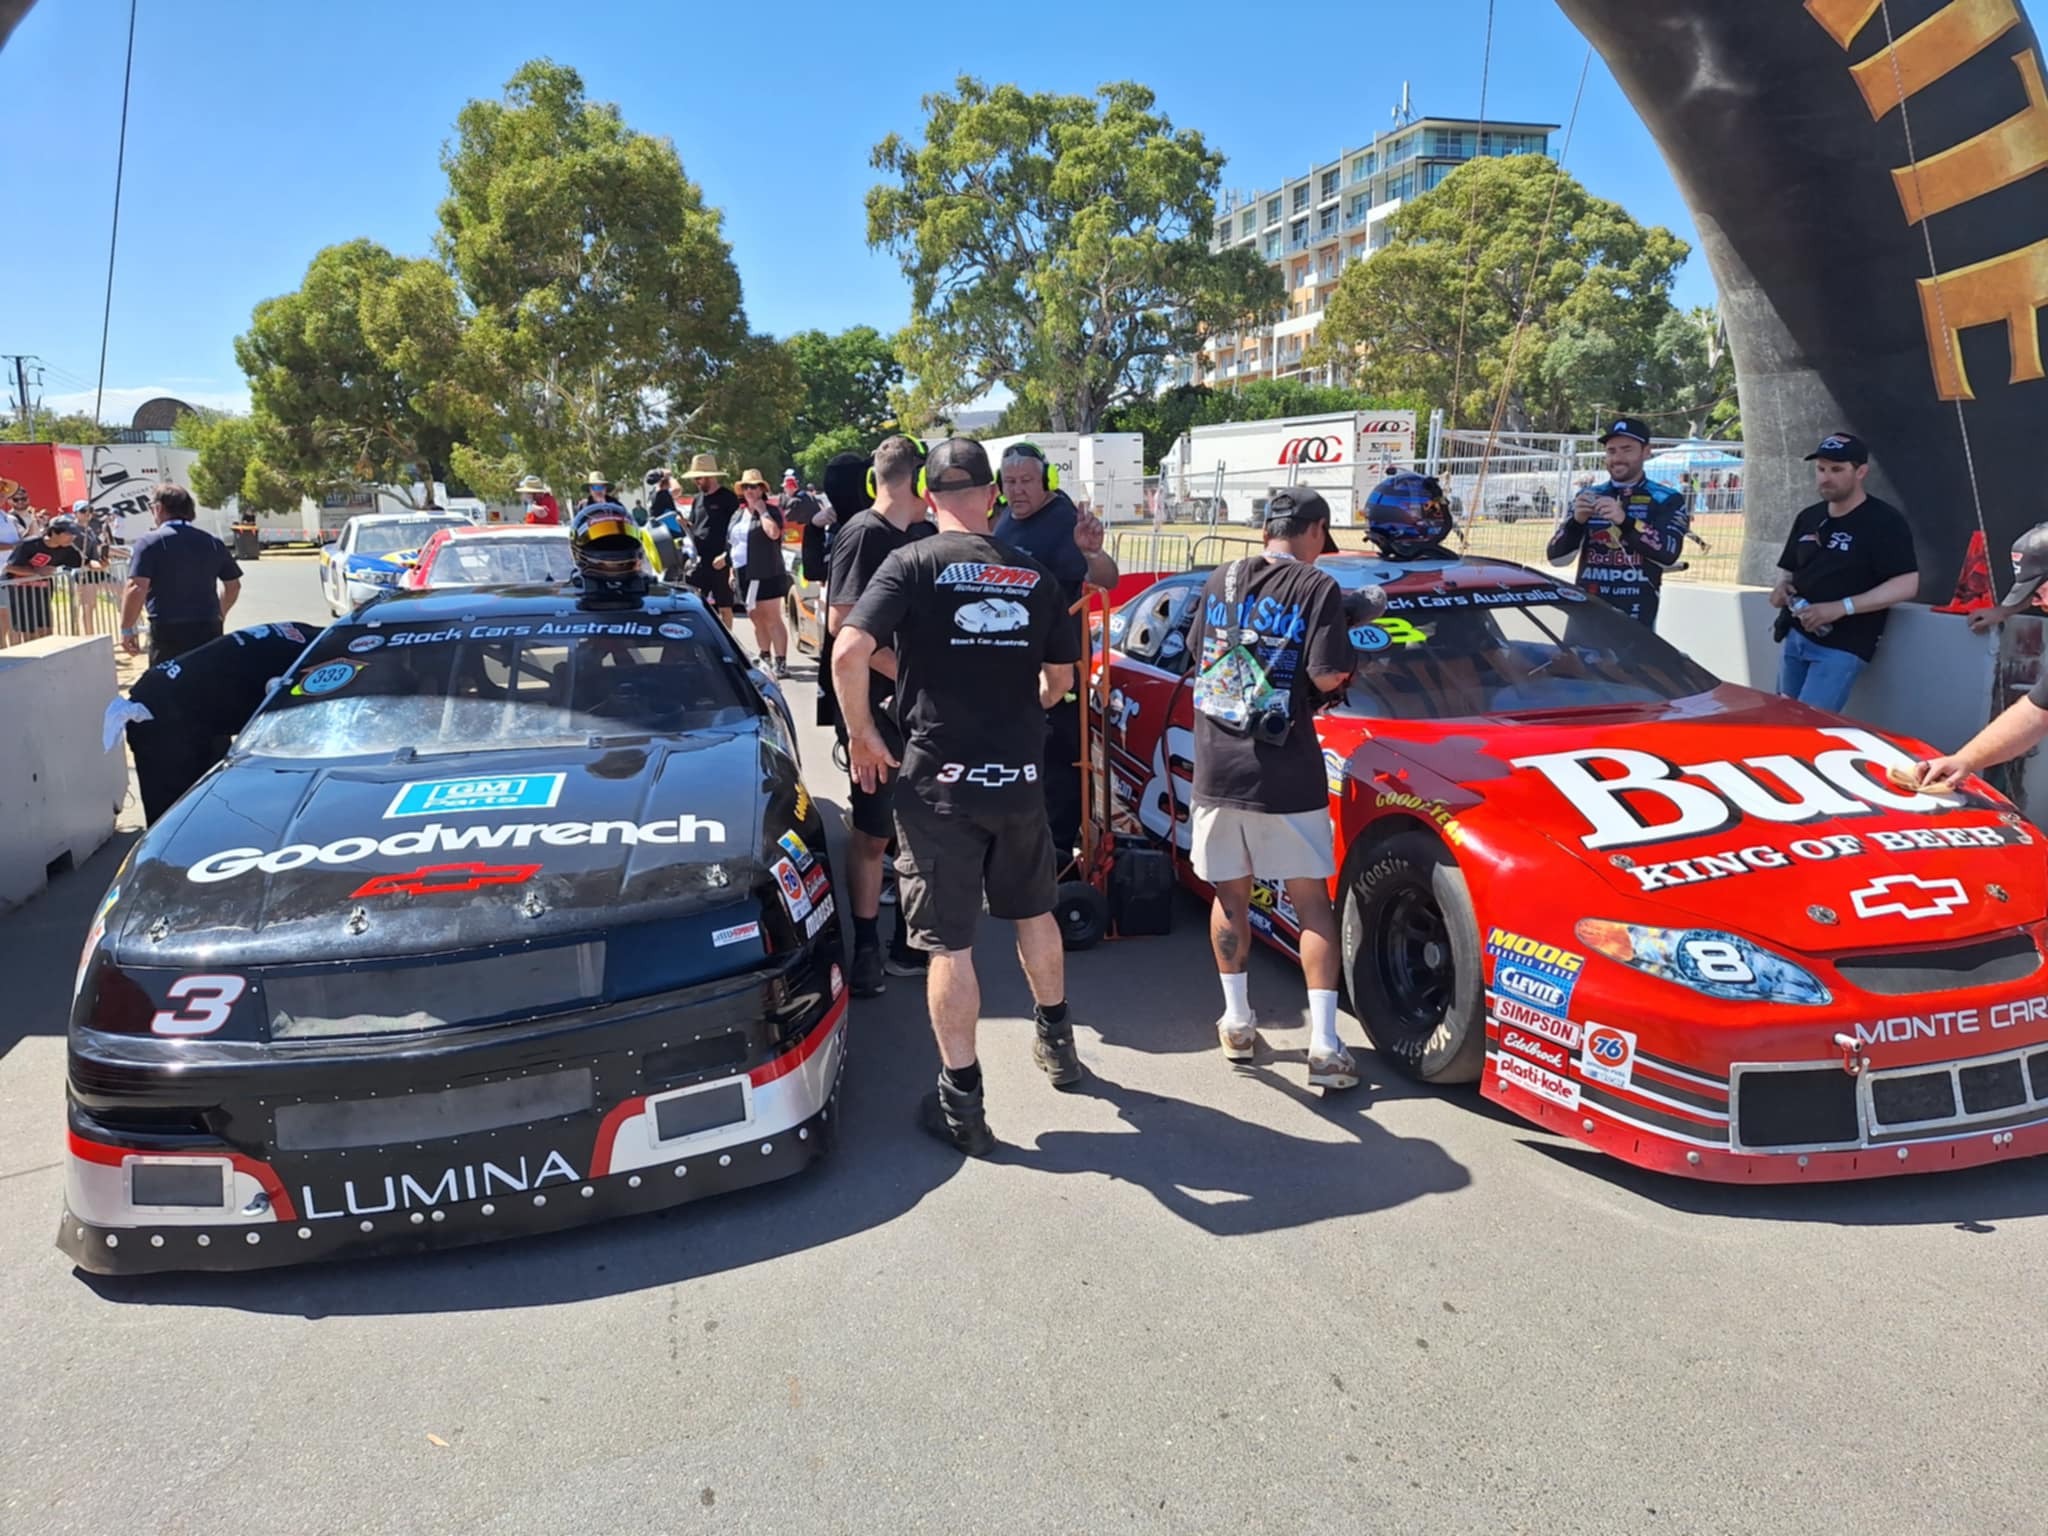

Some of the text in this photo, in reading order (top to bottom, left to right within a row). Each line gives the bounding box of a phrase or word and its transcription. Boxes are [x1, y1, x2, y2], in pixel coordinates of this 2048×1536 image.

[1581, 567, 1649, 582] AMPOL
[1418, 594, 1469, 608] Cars
[1472, 585, 1559, 604] Australia
[387, 627, 464, 646] Stock
[470, 624, 532, 638] Cars
[537, 622, 653, 636] Australia
[1352, 628, 1380, 646] 28
[312, 667, 348, 684] 333
[447, 779, 513, 796] GM
[936, 762, 1038, 783] 3 8
[1513, 727, 1968, 850] Bud
[422, 796, 519, 809] Parts
[186, 814, 727, 883] Goodwrench
[1626, 825, 2006, 891] KING OF BEER
[1488, 928, 1585, 972] MOOG
[1683, 939, 1757, 985] 8
[1501, 967, 1561, 1004] CLEVITE
[1538, 961, 1574, 980] PARTS
[152, 974, 246, 1036] 3
[1501, 1001, 1574, 1041] SIMPSON
[1854, 1008, 1980, 1044] MONTE
[1504, 1032, 1563, 1067] Edelbrock
[1594, 1036, 1623, 1059] 76
[1501, 1057, 1574, 1098] plasti-kote
[303, 1150, 581, 1221] LUMINA
